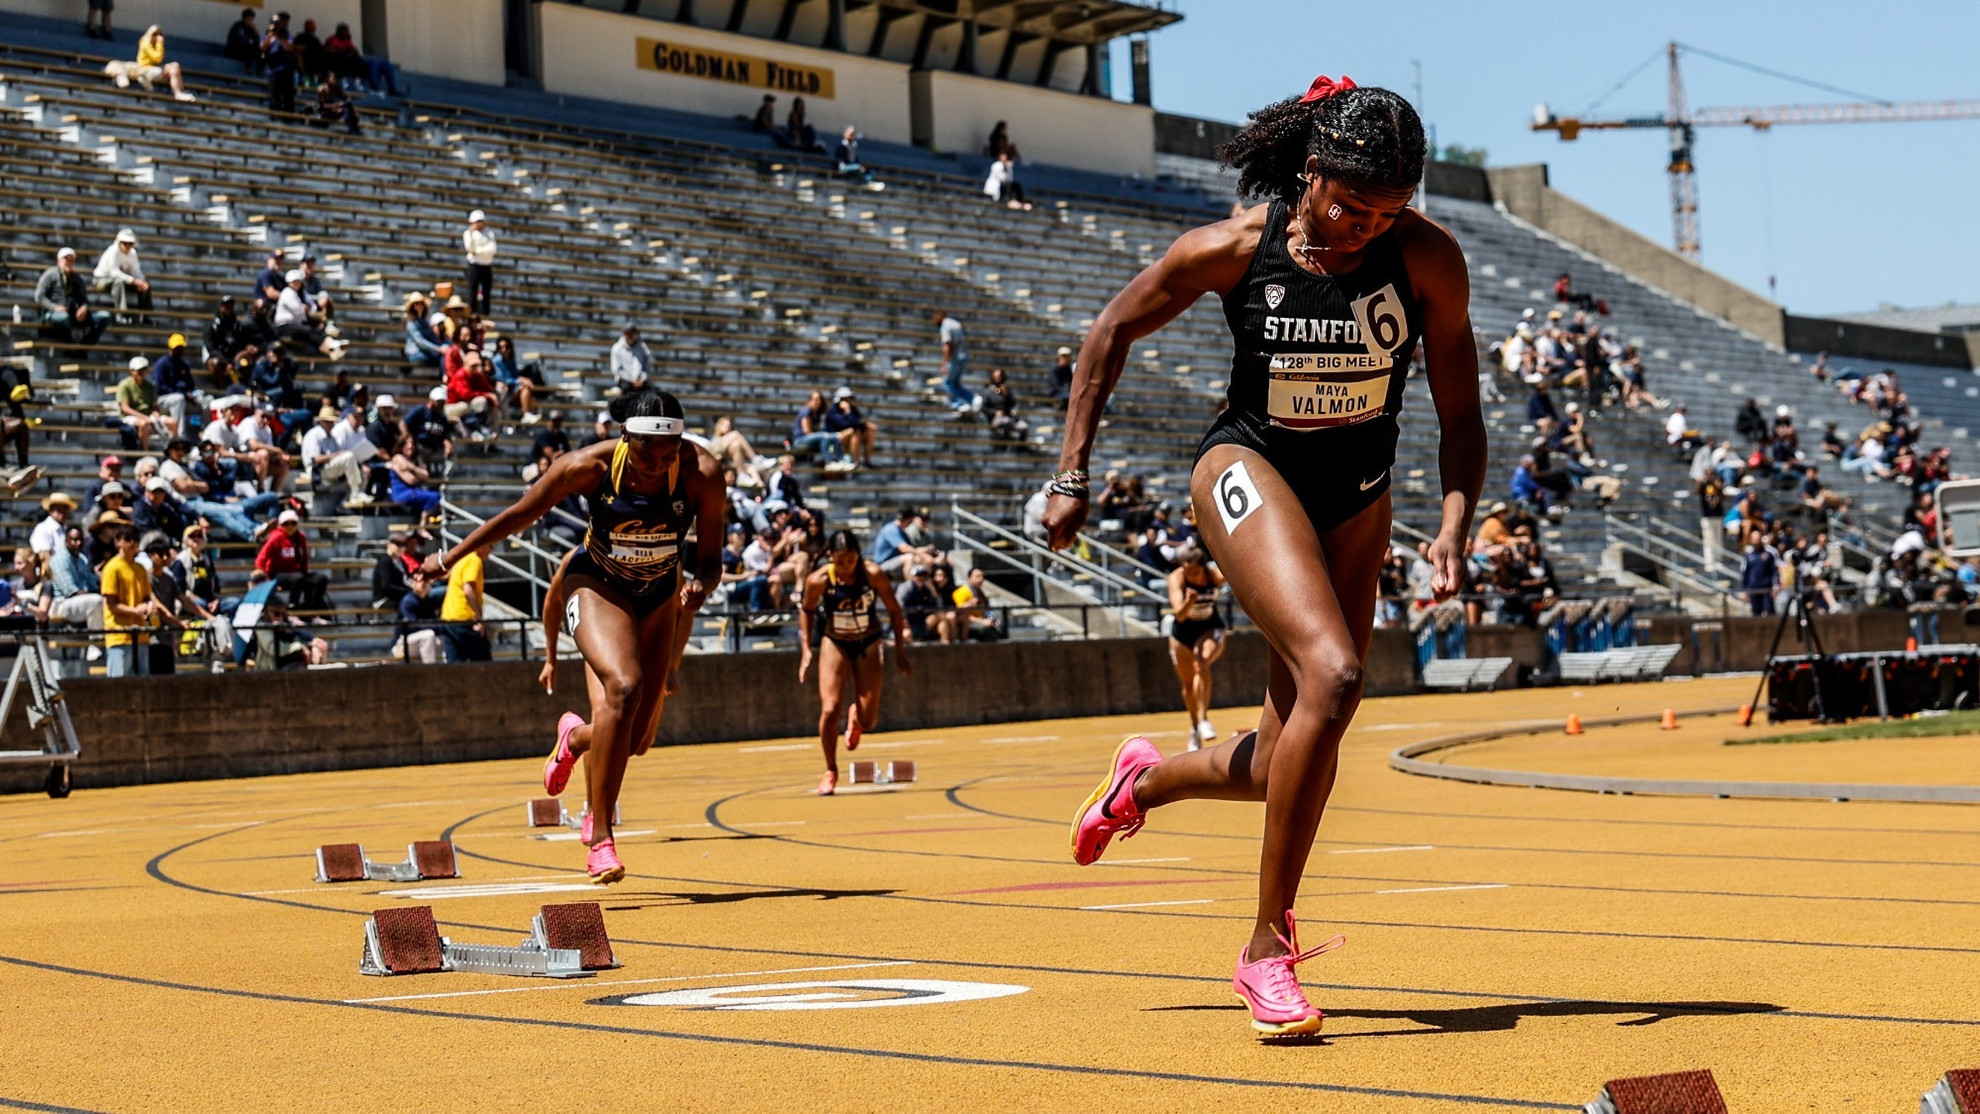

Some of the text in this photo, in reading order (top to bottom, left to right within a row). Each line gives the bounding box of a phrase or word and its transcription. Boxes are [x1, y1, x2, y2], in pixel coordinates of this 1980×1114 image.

[653, 42, 820, 94] GOLDMAN FIELD
[1263, 316, 1366, 344] STANFO
[1366, 292, 1400, 350] 6
[1280, 357, 1313, 369] 128th
[1317, 357, 1342, 369] BIG
[1292, 394, 1368, 415] VALMON
[1315, 384, 1349, 397] MAYA
[1220, 469, 1249, 519] 6
